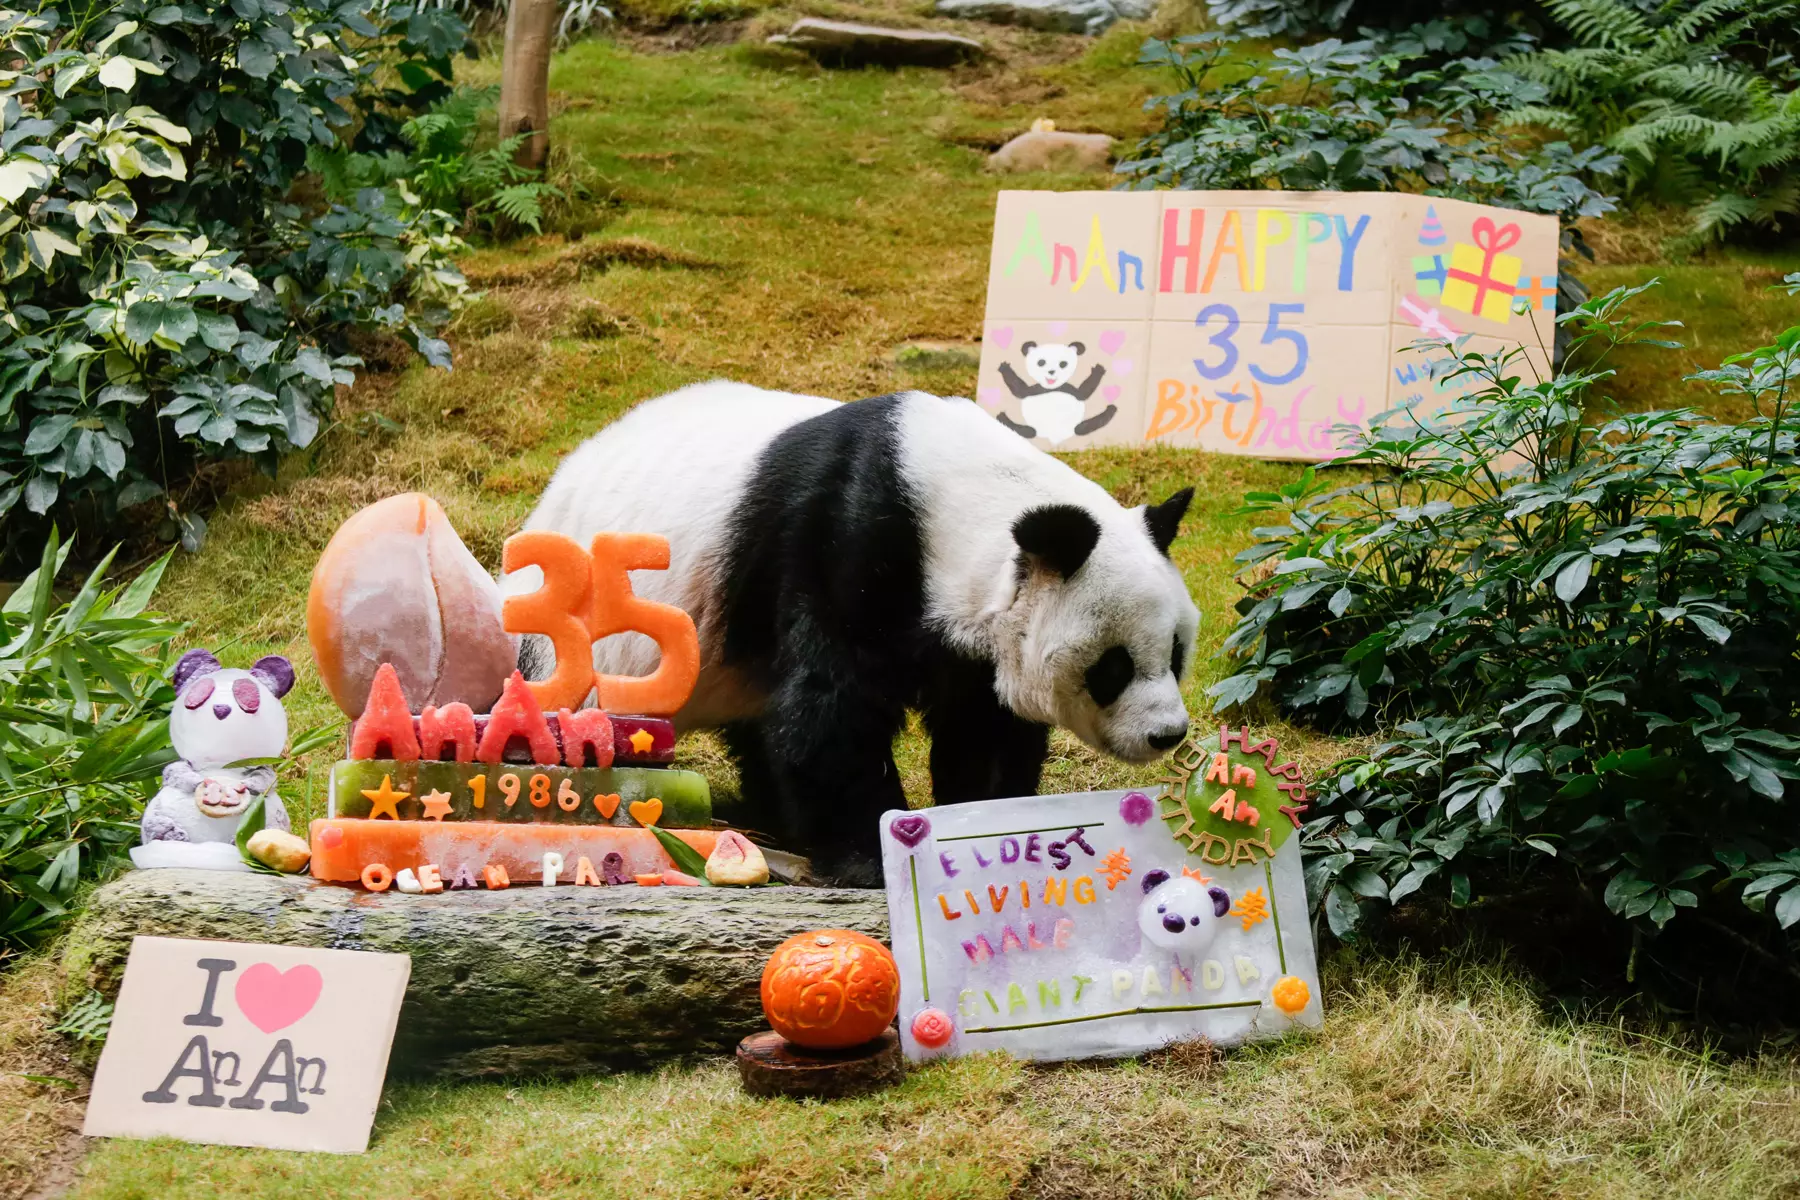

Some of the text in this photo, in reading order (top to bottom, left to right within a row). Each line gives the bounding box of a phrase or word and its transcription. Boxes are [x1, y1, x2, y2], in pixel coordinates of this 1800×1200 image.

[1004, 208, 1372, 294] AnAn HAPPY
[1192, 303, 1309, 386] 35
[503, 530, 699, 717] 35
[351, 662, 615, 768] AnAn
[468, 774, 581, 812] 1986
[1157, 739, 1276, 868] BIRTHDAY
[1219, 724, 1308, 829] HAPPY
[360, 862, 510, 895] OCEAN
[939, 827, 1095, 879] ELDEST
[937, 875, 1098, 921] LIVING
[960, 918, 1075, 968] MALE
[183, 958, 237, 1027] I
[958, 951, 1260, 1017] GIANT PANDA
[142, 1034, 327, 1114] AnAn
